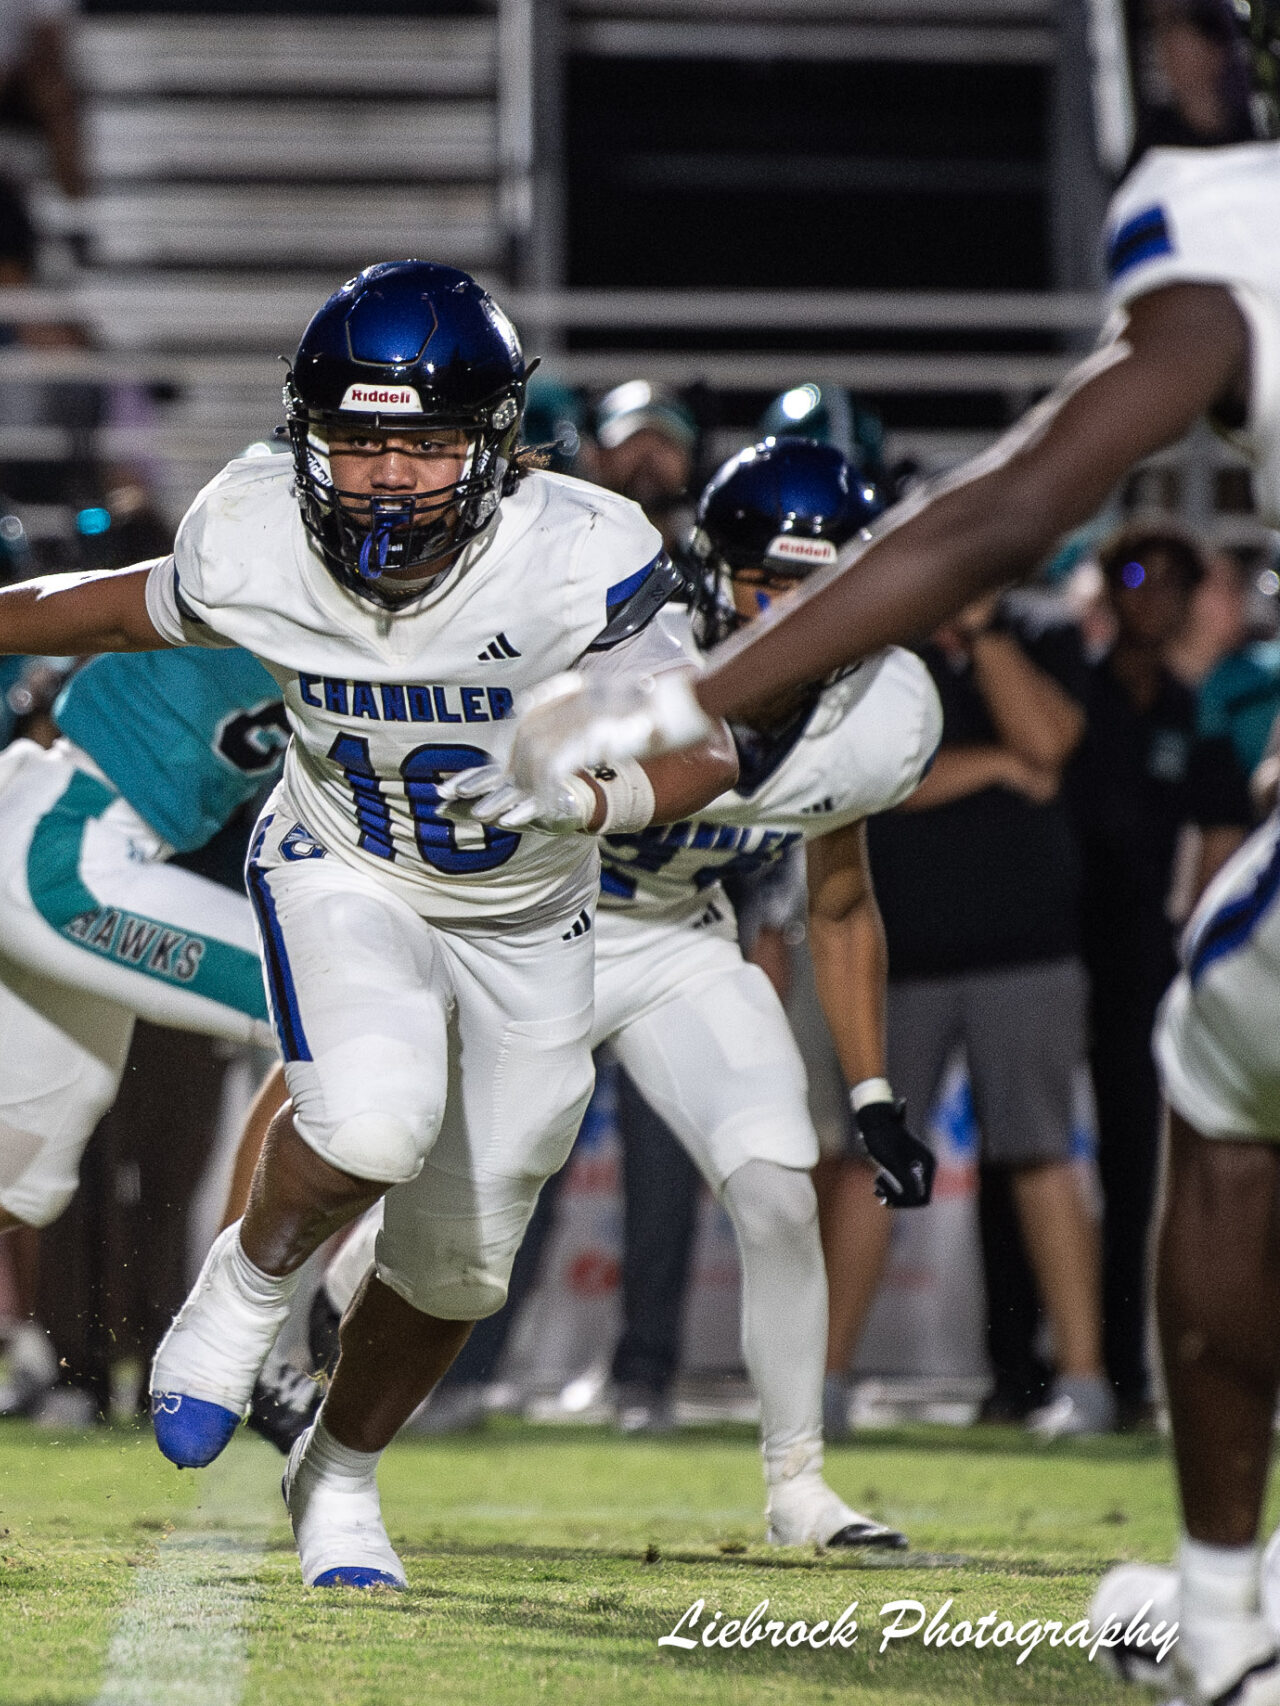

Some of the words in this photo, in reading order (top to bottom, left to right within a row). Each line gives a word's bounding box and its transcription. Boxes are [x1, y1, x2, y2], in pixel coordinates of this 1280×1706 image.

[351, 389, 411, 404] Riddell
[778, 542, 832, 558] Riddell
[298, 671, 515, 723] CHANDLER
